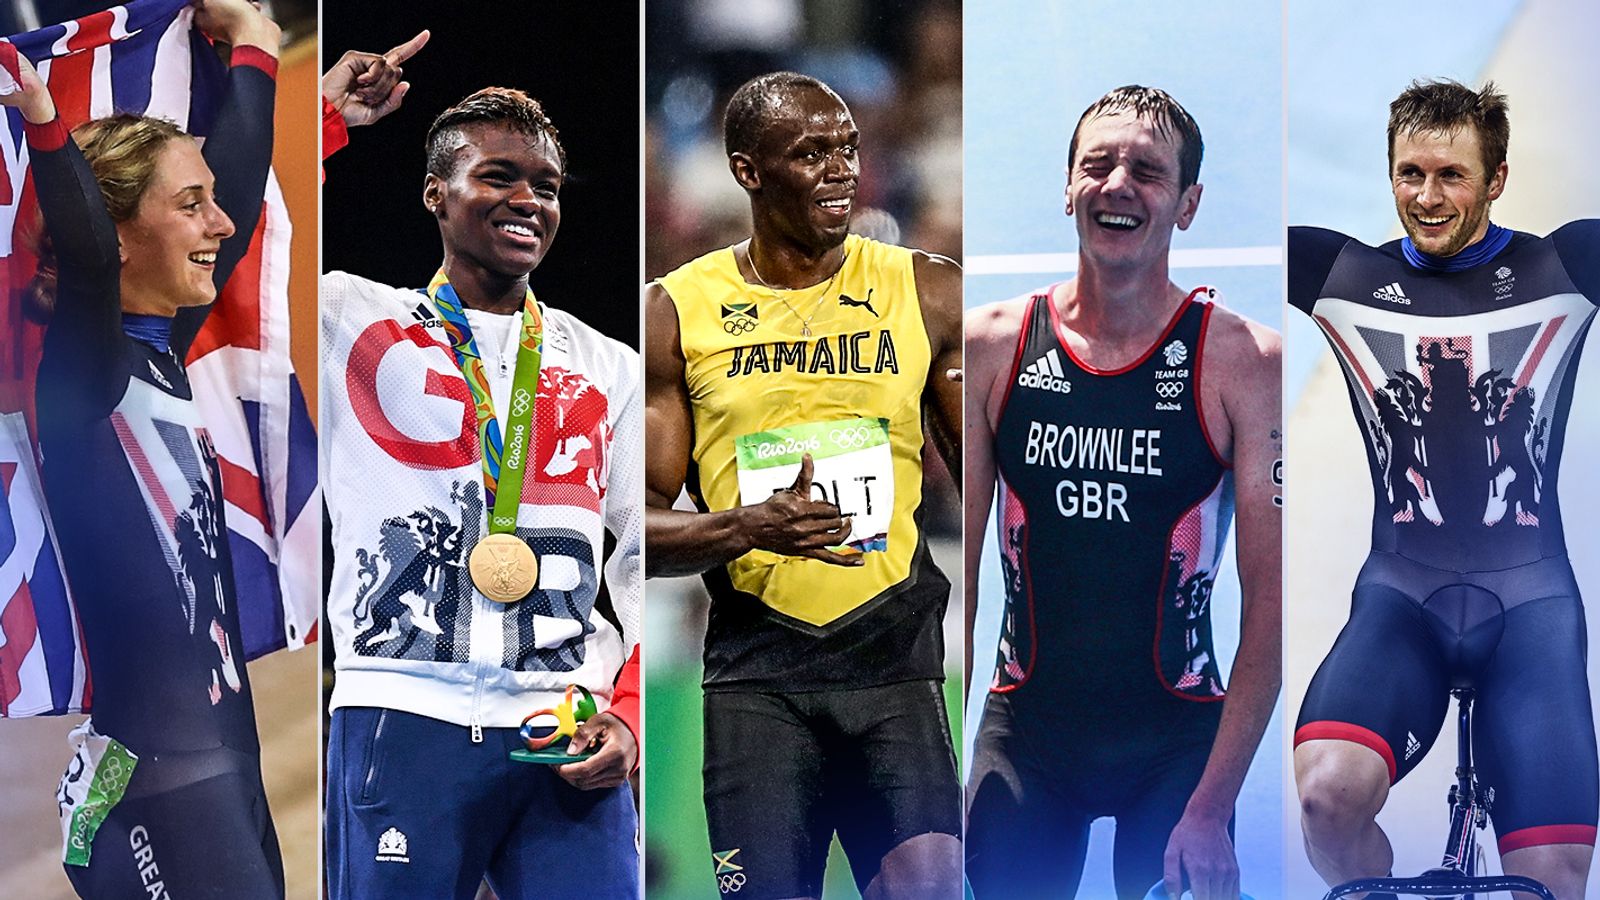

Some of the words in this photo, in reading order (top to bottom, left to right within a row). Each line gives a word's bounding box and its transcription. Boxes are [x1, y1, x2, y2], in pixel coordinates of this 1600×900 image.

[1373, 290, 1412, 306] adidas
[727, 329, 899, 378] JAMAICA
[1018, 372, 1072, 394] adidas
[1154, 370, 1176, 379] TEAM
[1176, 369, 1190, 379] GB
[506, 424, 525, 470] Rio2016
[757, 434, 821, 459] Rio2016
[1025, 420, 1163, 477] BROWNLEE
[1055, 479, 1131, 523] GBR
